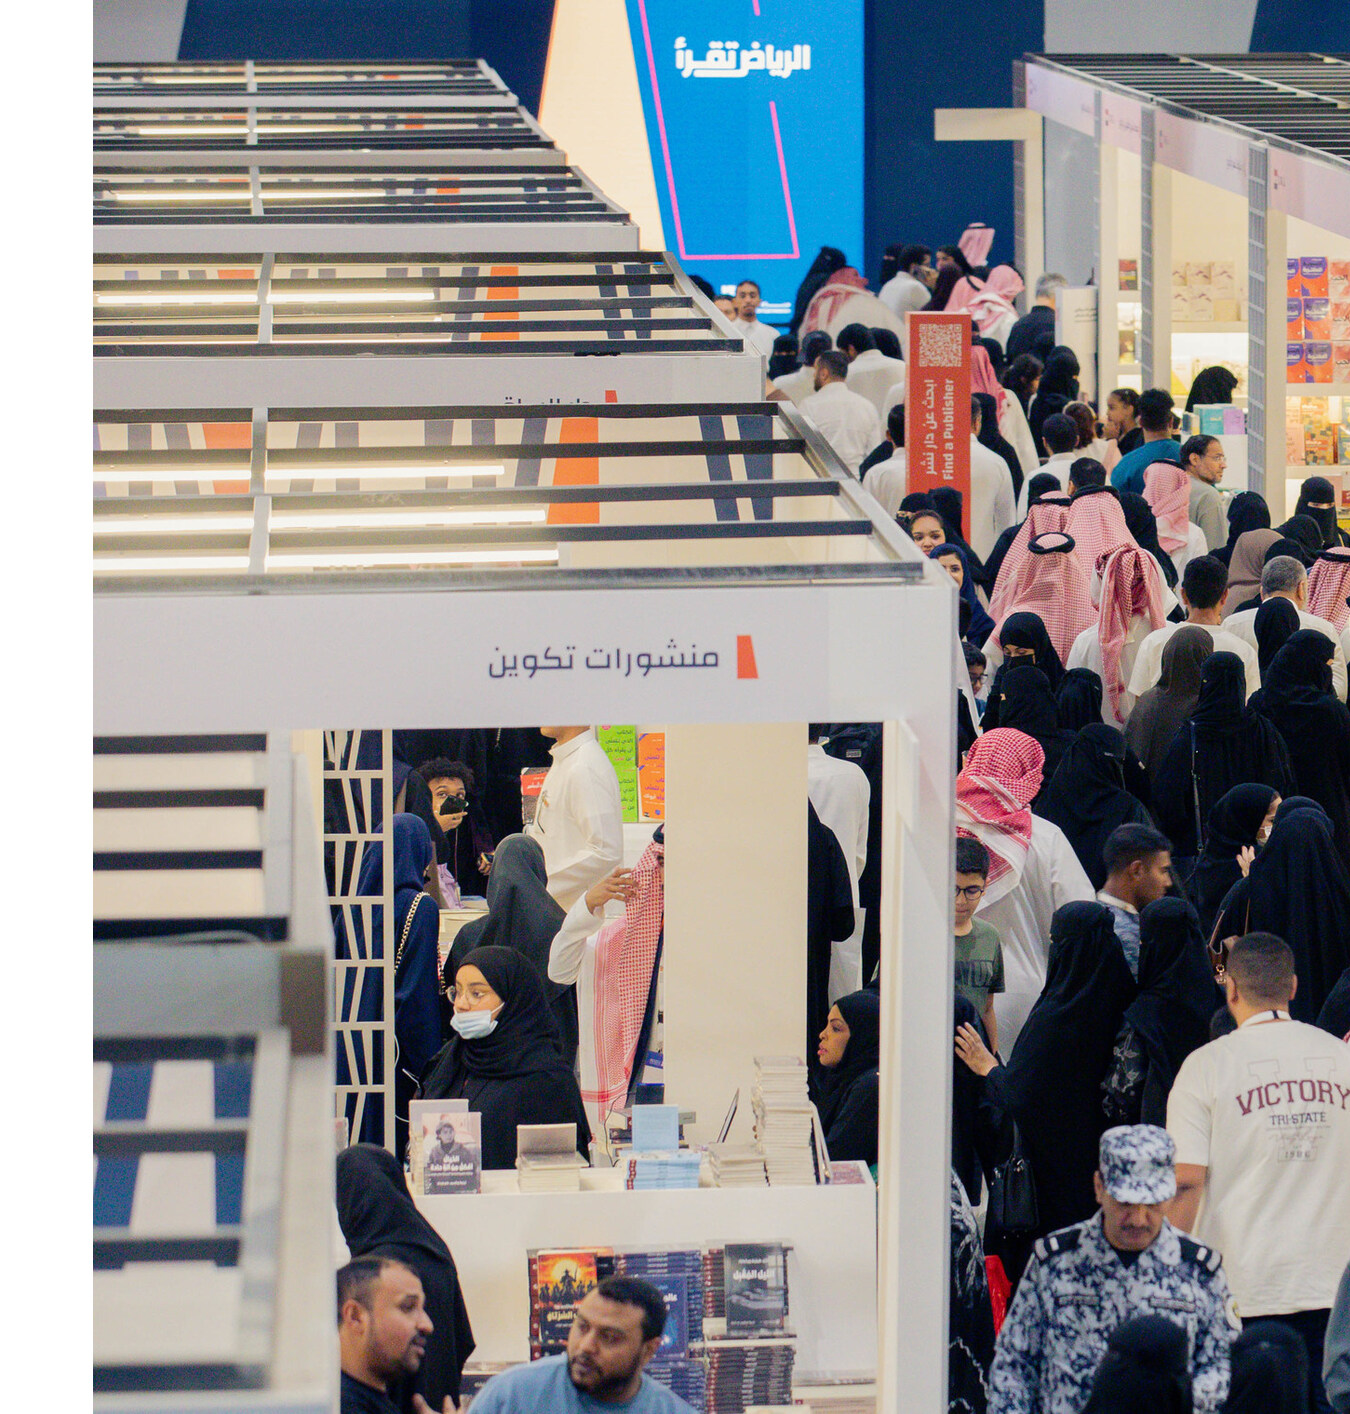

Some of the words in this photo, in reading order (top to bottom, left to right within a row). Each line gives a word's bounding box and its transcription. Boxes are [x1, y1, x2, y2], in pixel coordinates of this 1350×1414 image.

[674, 36, 741, 78] تقرأ
[739, 41, 811, 78] الرياض
[923, 411, 938, 429] عن
[942, 379, 955, 438] Publisher
[924, 433, 938, 449] دار
[944, 440, 954, 450] a
[920, 452, 938, 476] نشر
[942, 454, 954, 480] Find
[489, 645, 574, 679] تكوين
[585, 639, 719, 679] منشورات
[1269, 1111, 1327, 1126] TRI-STATE
